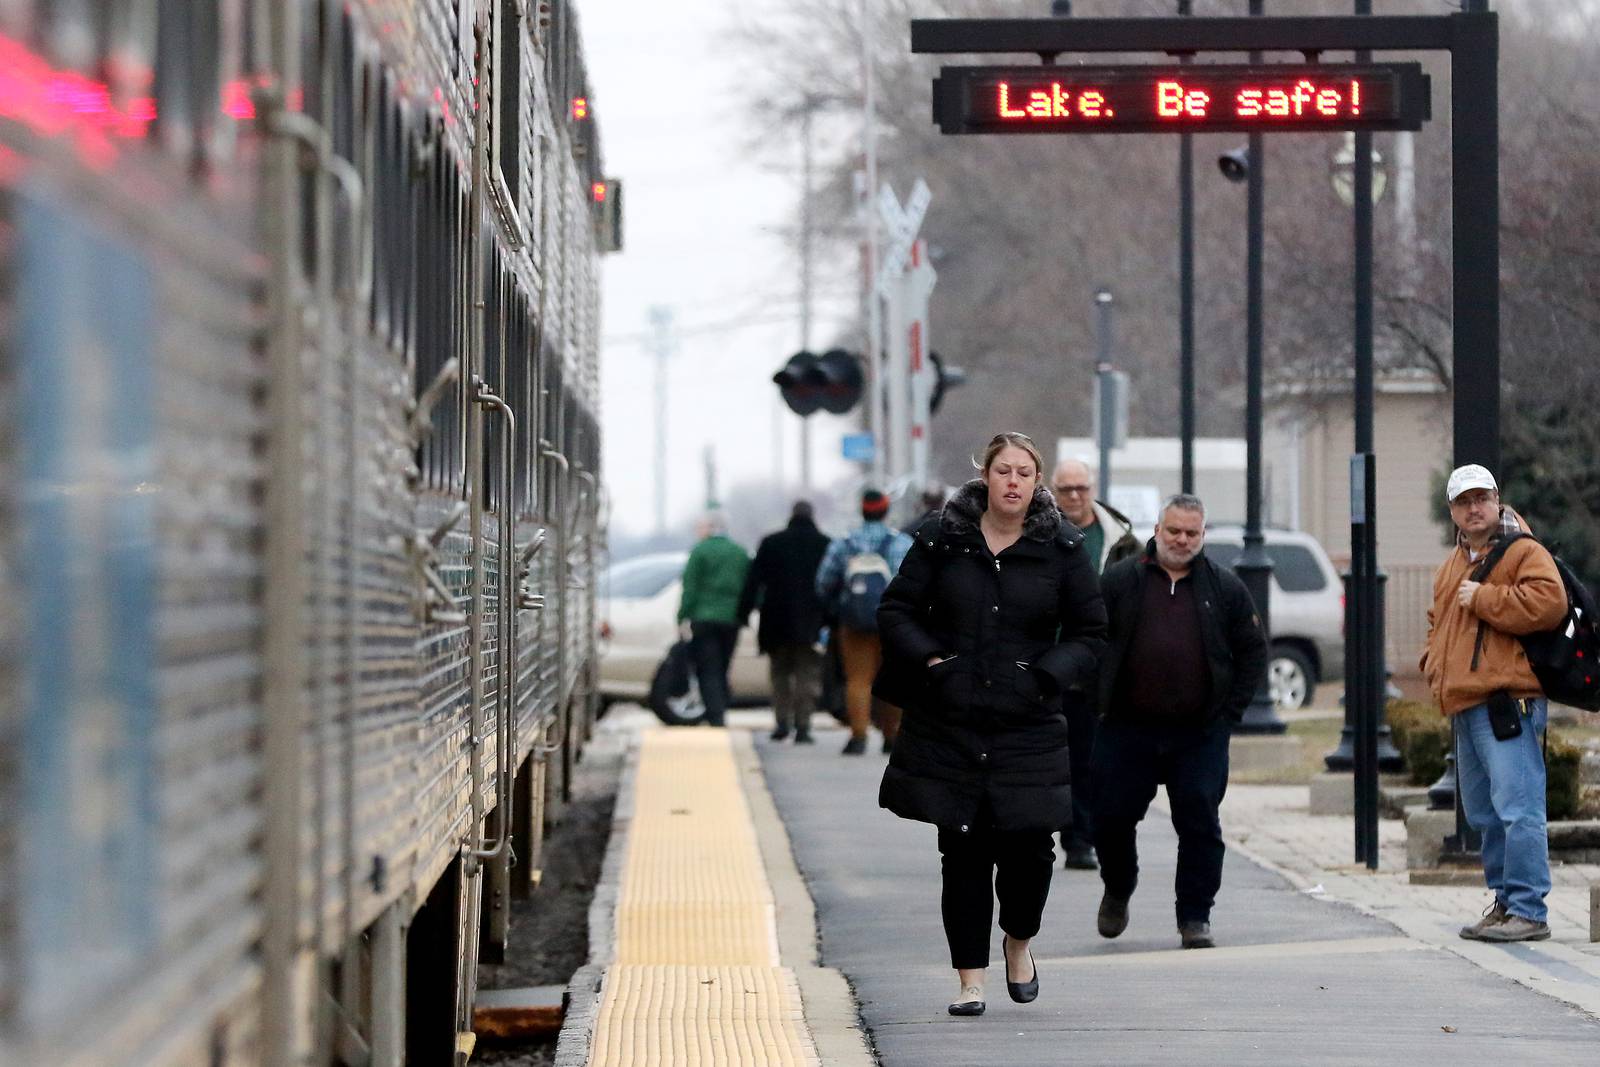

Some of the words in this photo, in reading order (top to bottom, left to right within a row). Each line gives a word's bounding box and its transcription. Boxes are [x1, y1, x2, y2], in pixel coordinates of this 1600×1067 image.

[998, 81, 1114, 119] Lake.
[1156, 80, 1210, 118] Be
[1236, 79, 1361, 117] safe!
